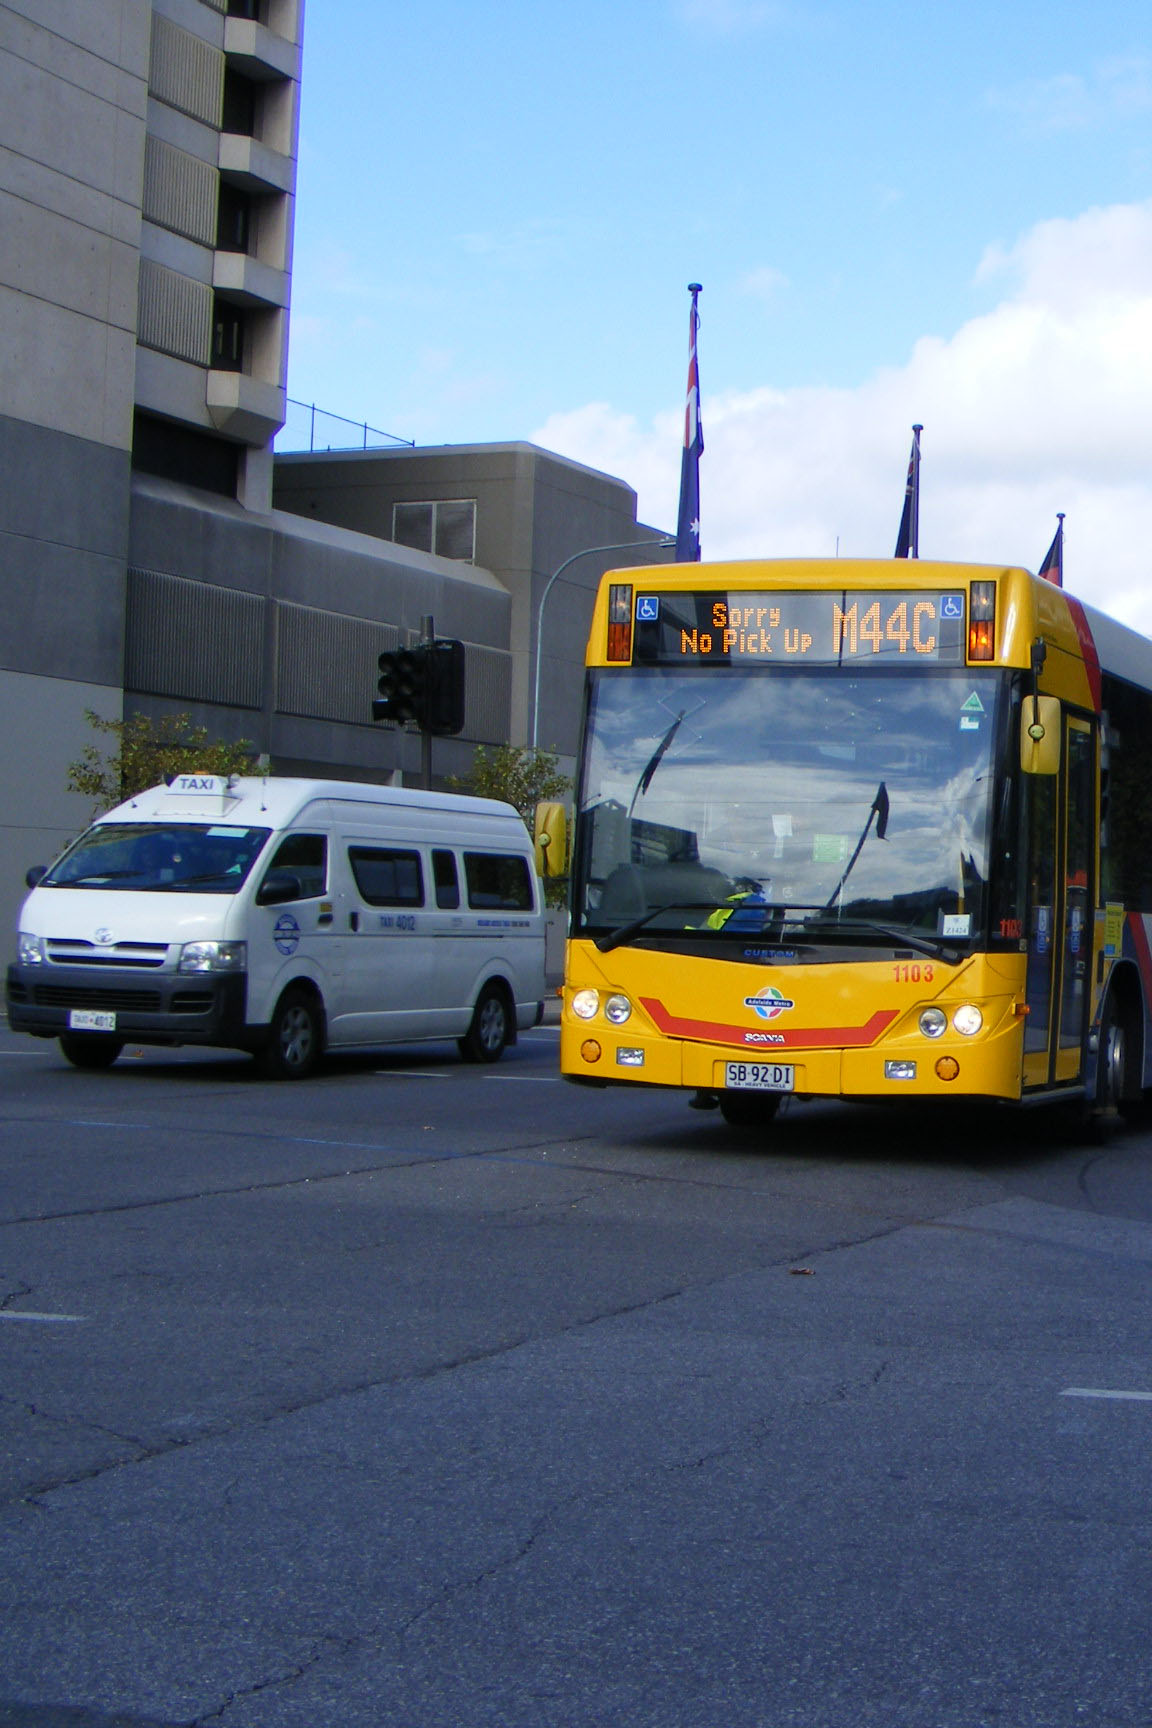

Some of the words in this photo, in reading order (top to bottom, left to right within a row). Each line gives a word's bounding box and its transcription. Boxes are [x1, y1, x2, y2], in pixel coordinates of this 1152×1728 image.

[713, 602, 780, 627] Sorry
[833, 602, 937, 654] M44C
[681, 629, 712, 653] No
[723, 629, 773, 653] Pick
[785, 629, 812, 653] Up
[180, 778, 214, 790] TAXI
[396, 915, 416, 931] 4012
[744, 949, 794, 958] CUSTOM
[893, 965, 934, 982] 1103
[744, 1033, 786, 1042] SCANIA
